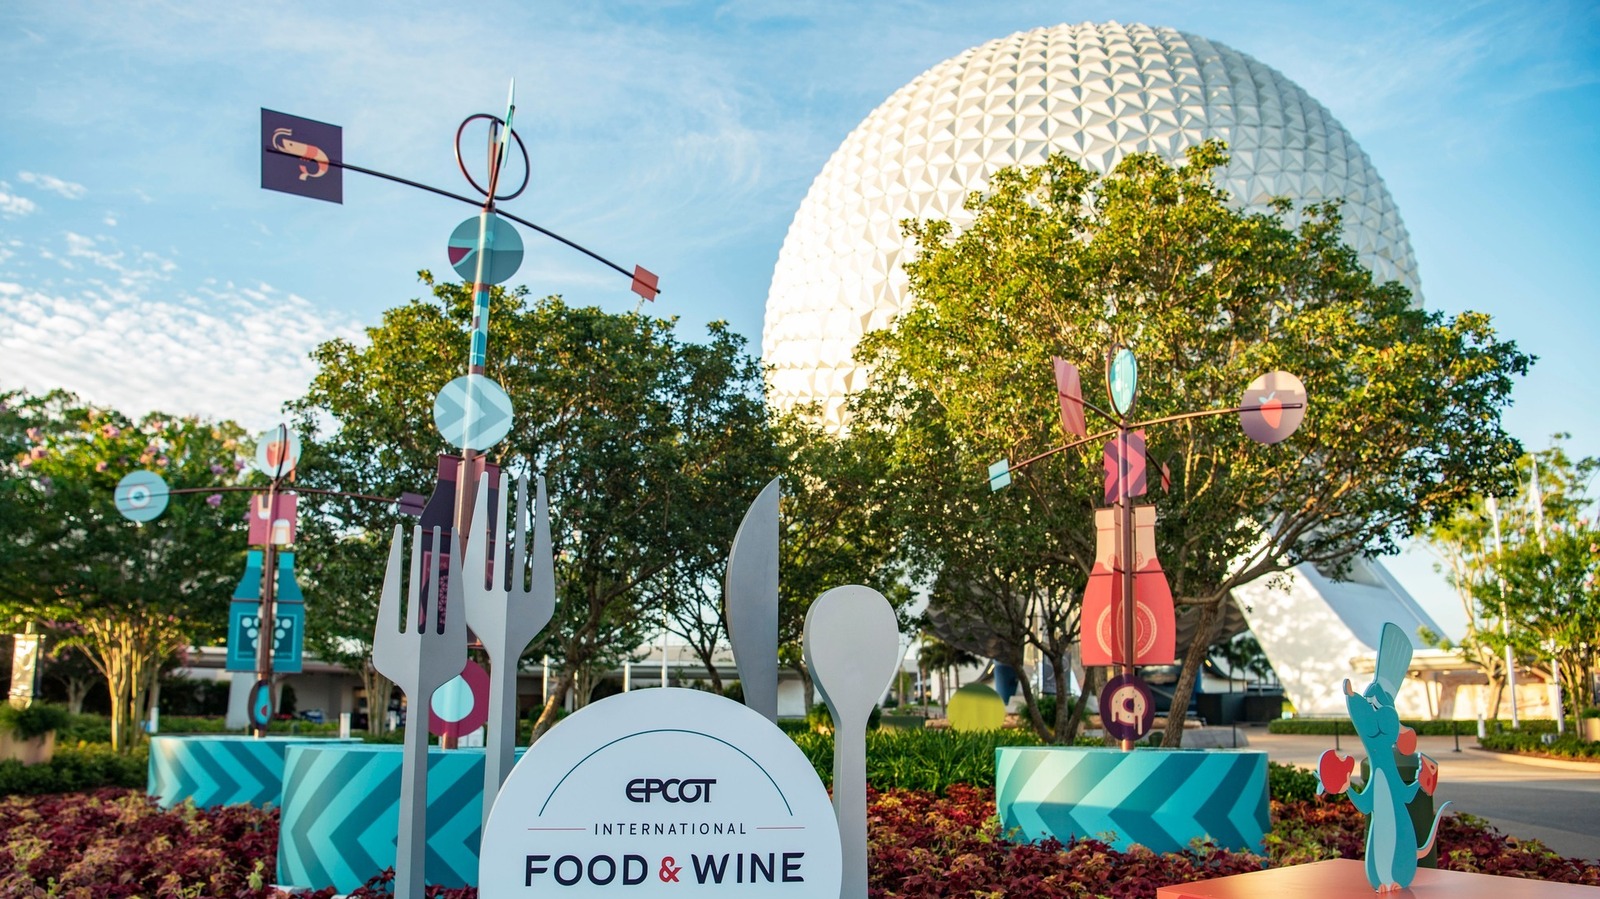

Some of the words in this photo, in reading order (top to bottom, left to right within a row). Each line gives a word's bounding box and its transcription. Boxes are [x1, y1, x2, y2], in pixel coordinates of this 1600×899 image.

[625, 778, 717, 804] EPCOT
[594, 822, 746, 836] INTERNATIONAL
[524, 854, 649, 887] FOOD
[658, 856, 683, 883] &
[690, 852, 805, 885] WINE
